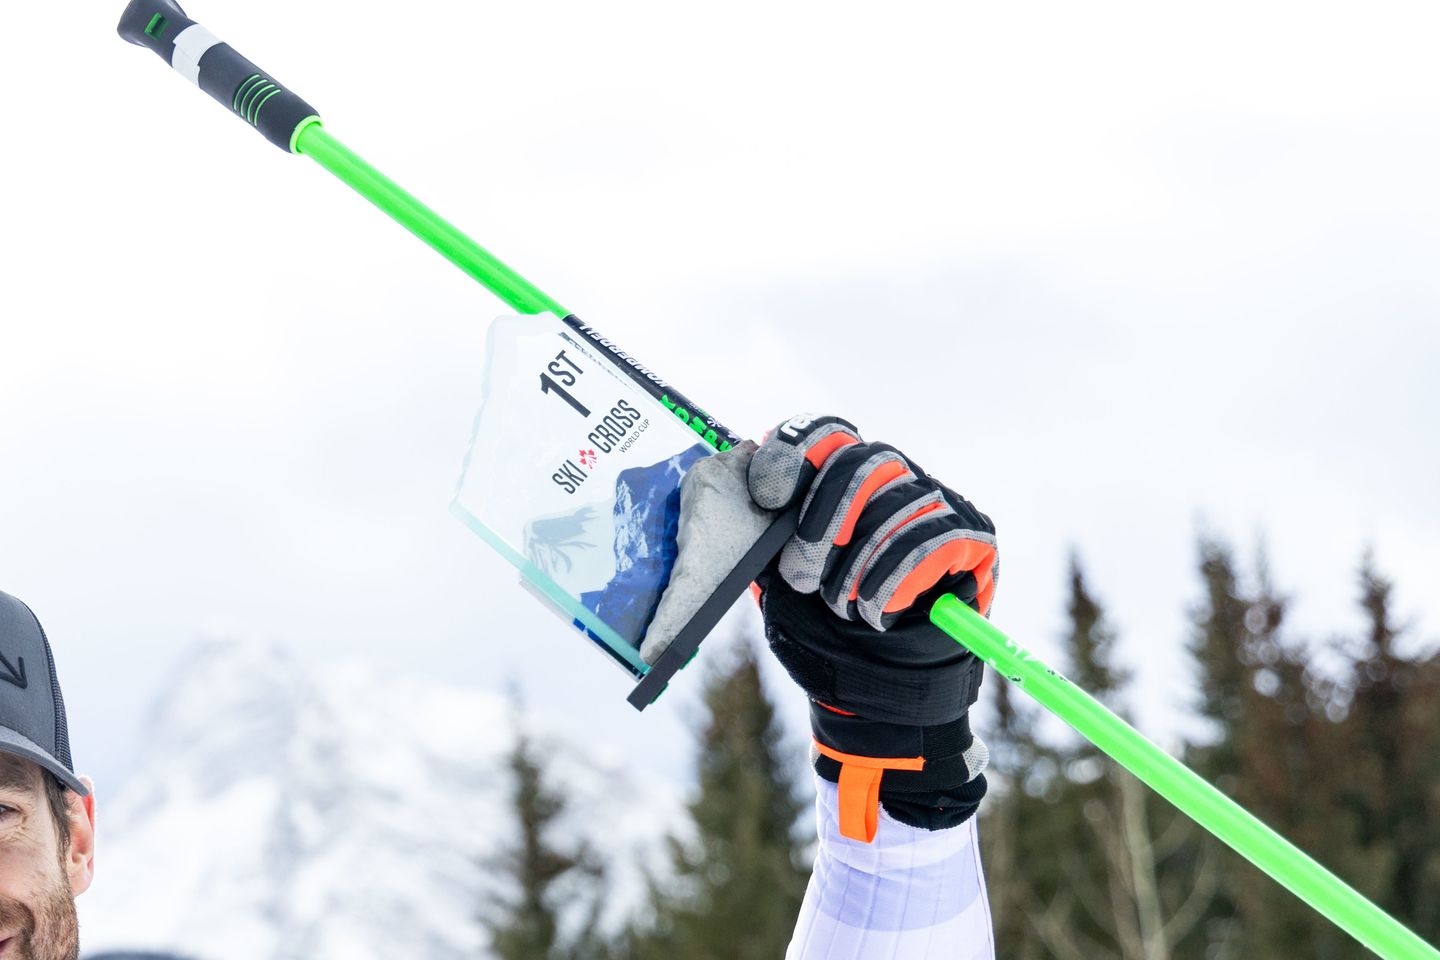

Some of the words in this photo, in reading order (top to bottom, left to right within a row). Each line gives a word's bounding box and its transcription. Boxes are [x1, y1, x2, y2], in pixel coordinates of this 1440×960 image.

[540, 349, 591, 418] 1ST
[551, 459, 588, 494] SKI
[587, 399, 641, 454] CROSS
